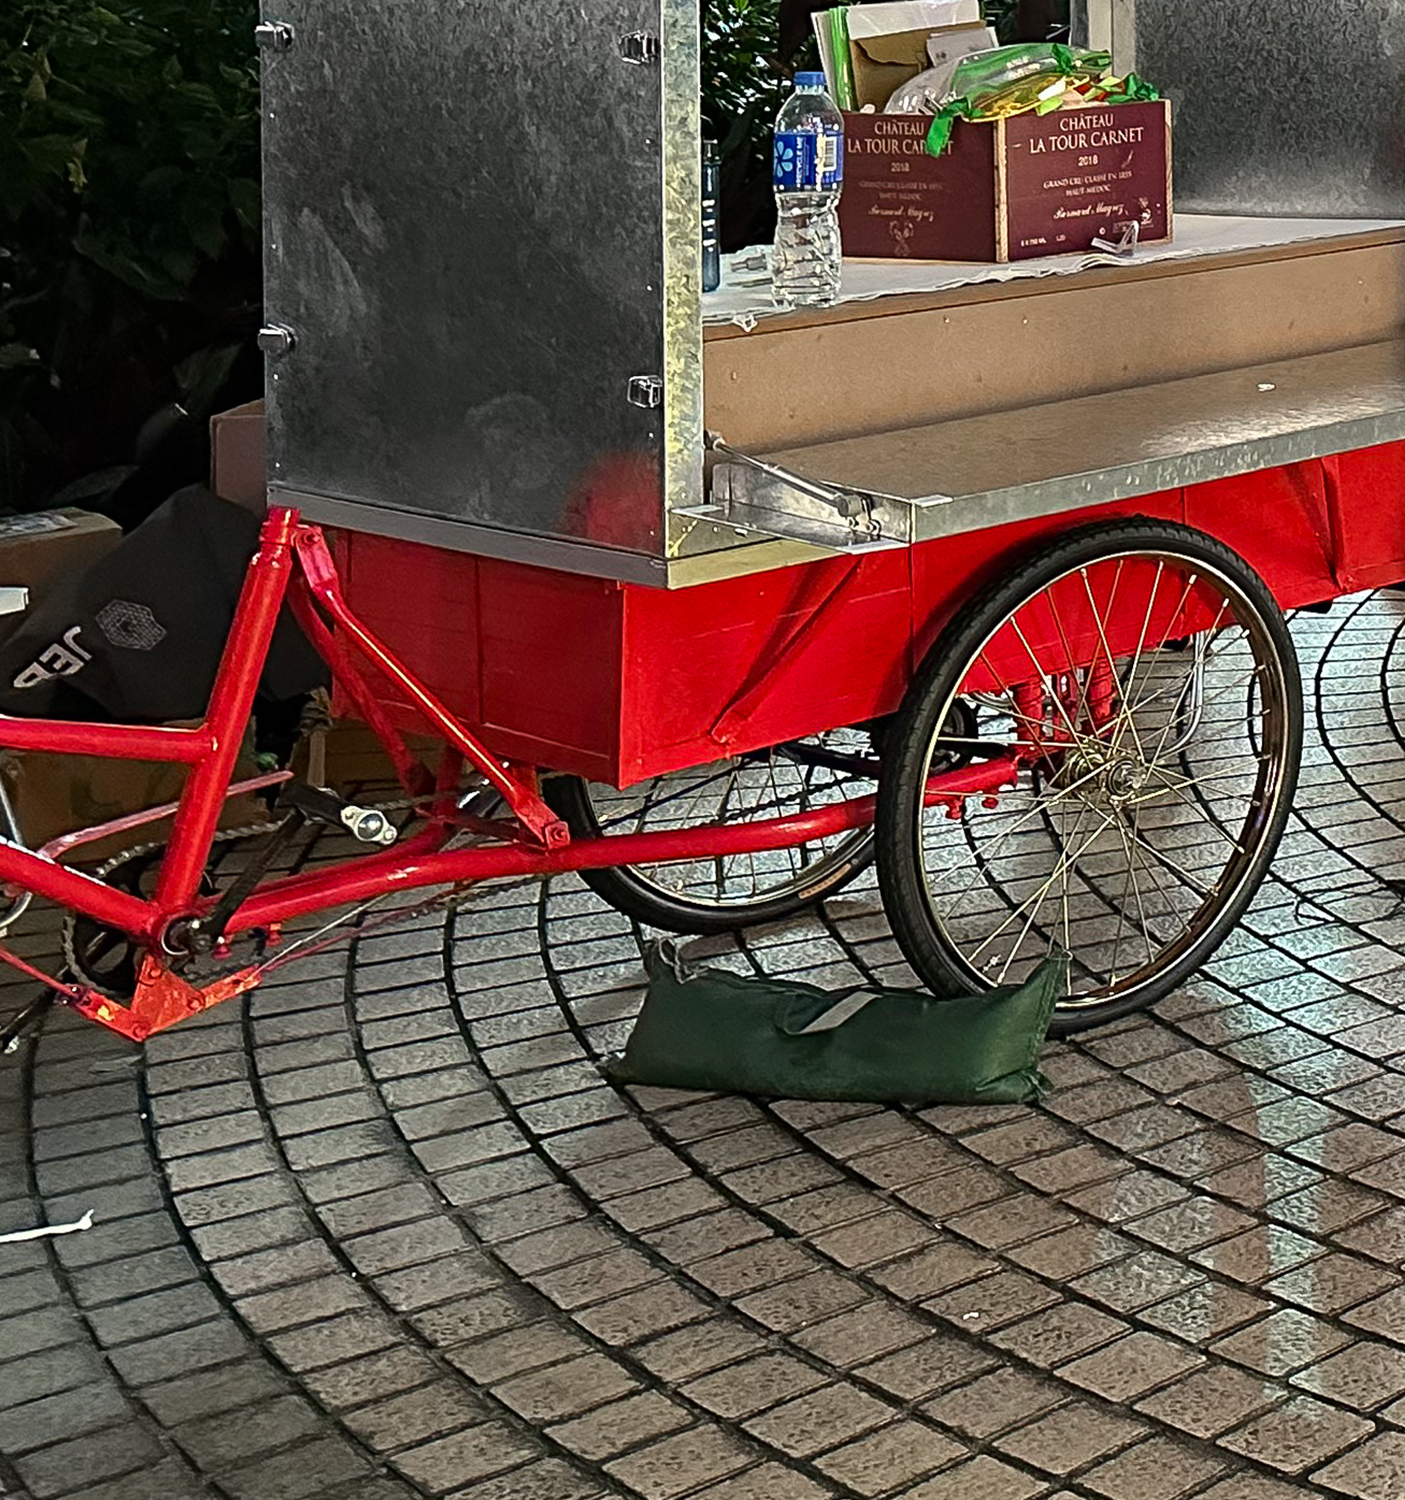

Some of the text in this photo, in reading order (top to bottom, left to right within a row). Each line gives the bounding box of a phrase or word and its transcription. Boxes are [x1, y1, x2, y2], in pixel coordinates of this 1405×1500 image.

[874, 119, 925, 135] CHÂTEAU
[1059, 113, 1114, 132] CHÂTEAU
[847, 138, 861, 153] LA
[864, 138, 900, 154] TOUR
[1029, 127, 1144, 154] LA TOUR CARNET
[1078, 154, 1099, 167] 2018
